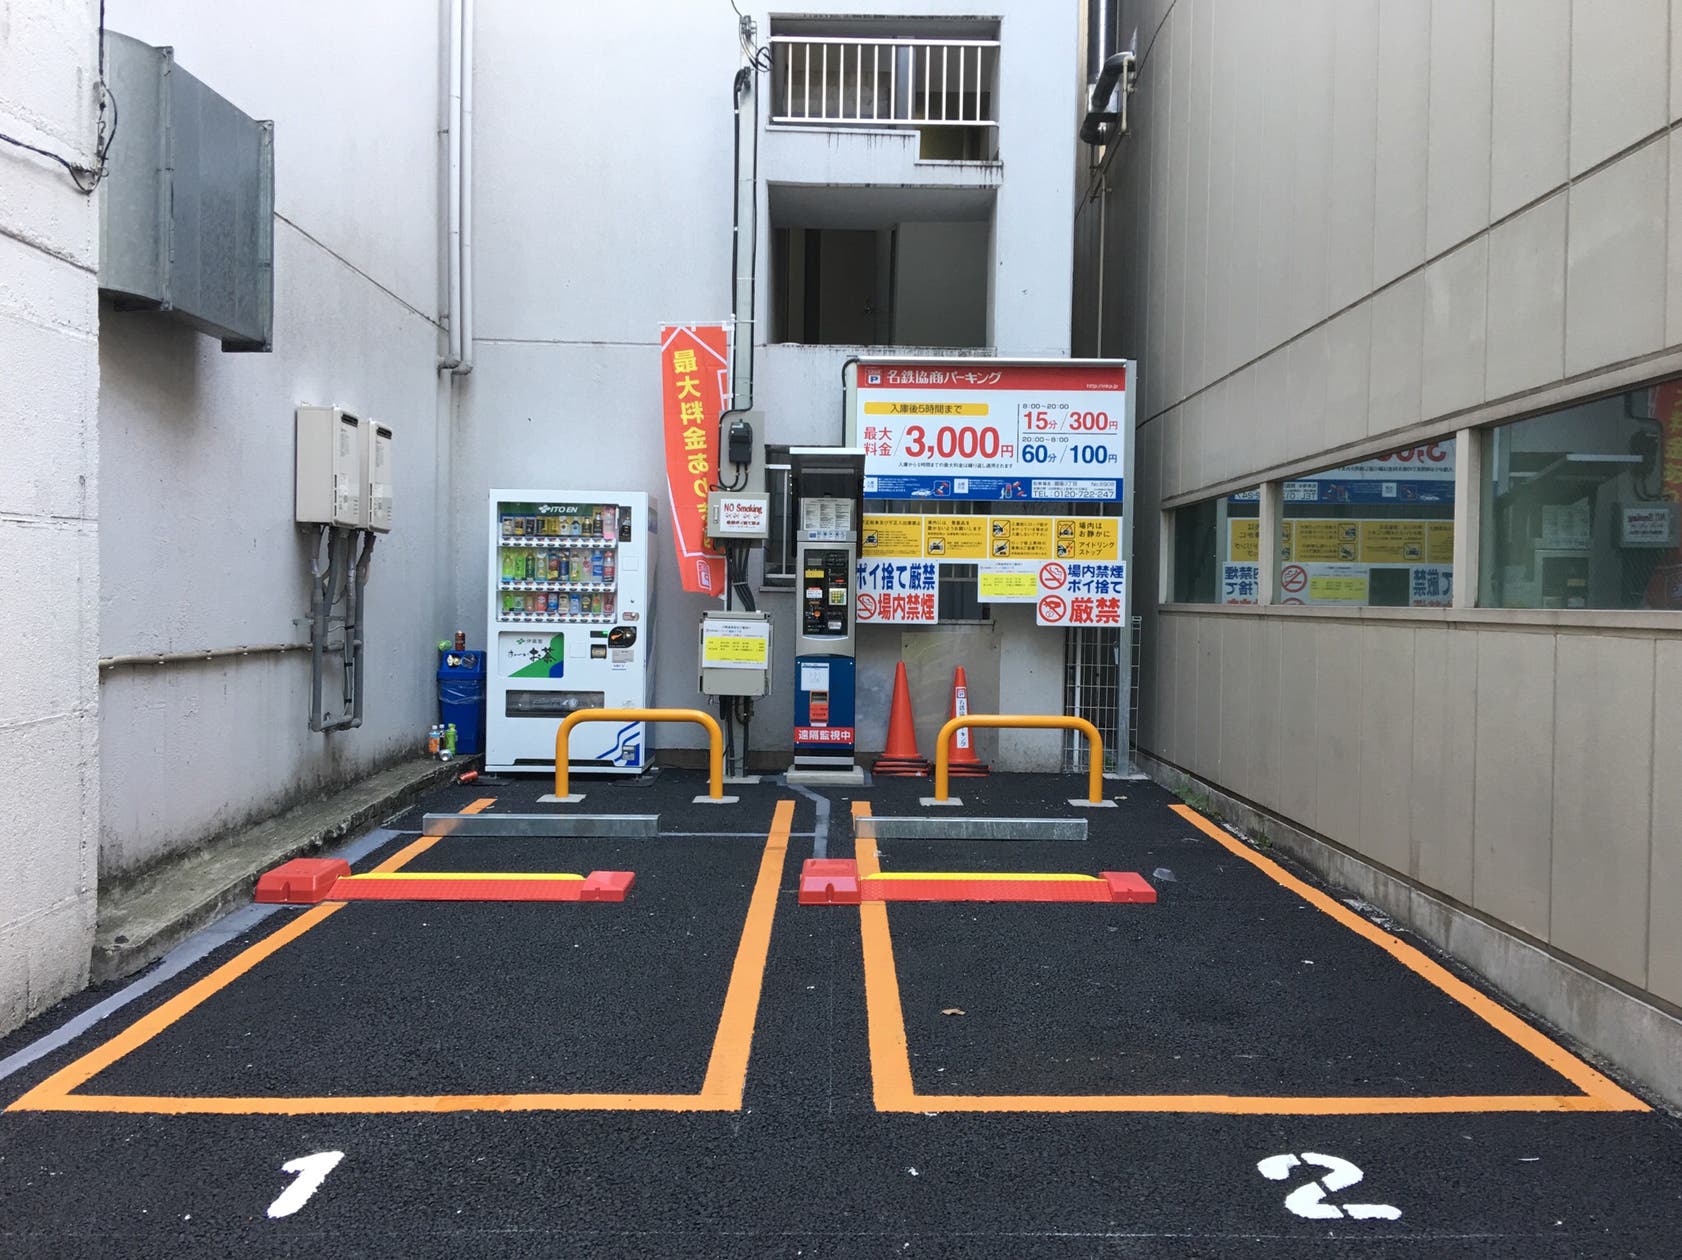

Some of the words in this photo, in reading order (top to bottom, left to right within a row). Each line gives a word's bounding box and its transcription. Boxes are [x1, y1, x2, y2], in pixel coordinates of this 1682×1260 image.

[887, 370, 1001, 384] 名鉄協商パーキング
[890, 404, 962, 414] 入庫後5時間まで
[864, 426, 893, 441] 最大
[864, 442, 892, 456] 料金
[905, 425, 1014, 459] 3,000円
[724, 503, 734, 512] NO
[736, 503, 763, 514] Smoking
[1079, 541, 1115, 549] アイドリング
[1079, 548, 1102, 556] ストップ
[857, 562, 936, 590] ポイ捨て厳禁
[1068, 564, 1124, 579] 場内禁煙
[1068, 579, 1123, 594] ポイ捨て
[878, 593, 935, 621] 場内禁煙
[1069, 597, 1121, 624] 厳禁
[798, 729, 851, 741] 遠隔監視中
[266, 1151, 345, 1219] 1
[1257, 1152, 1402, 1220] 2
